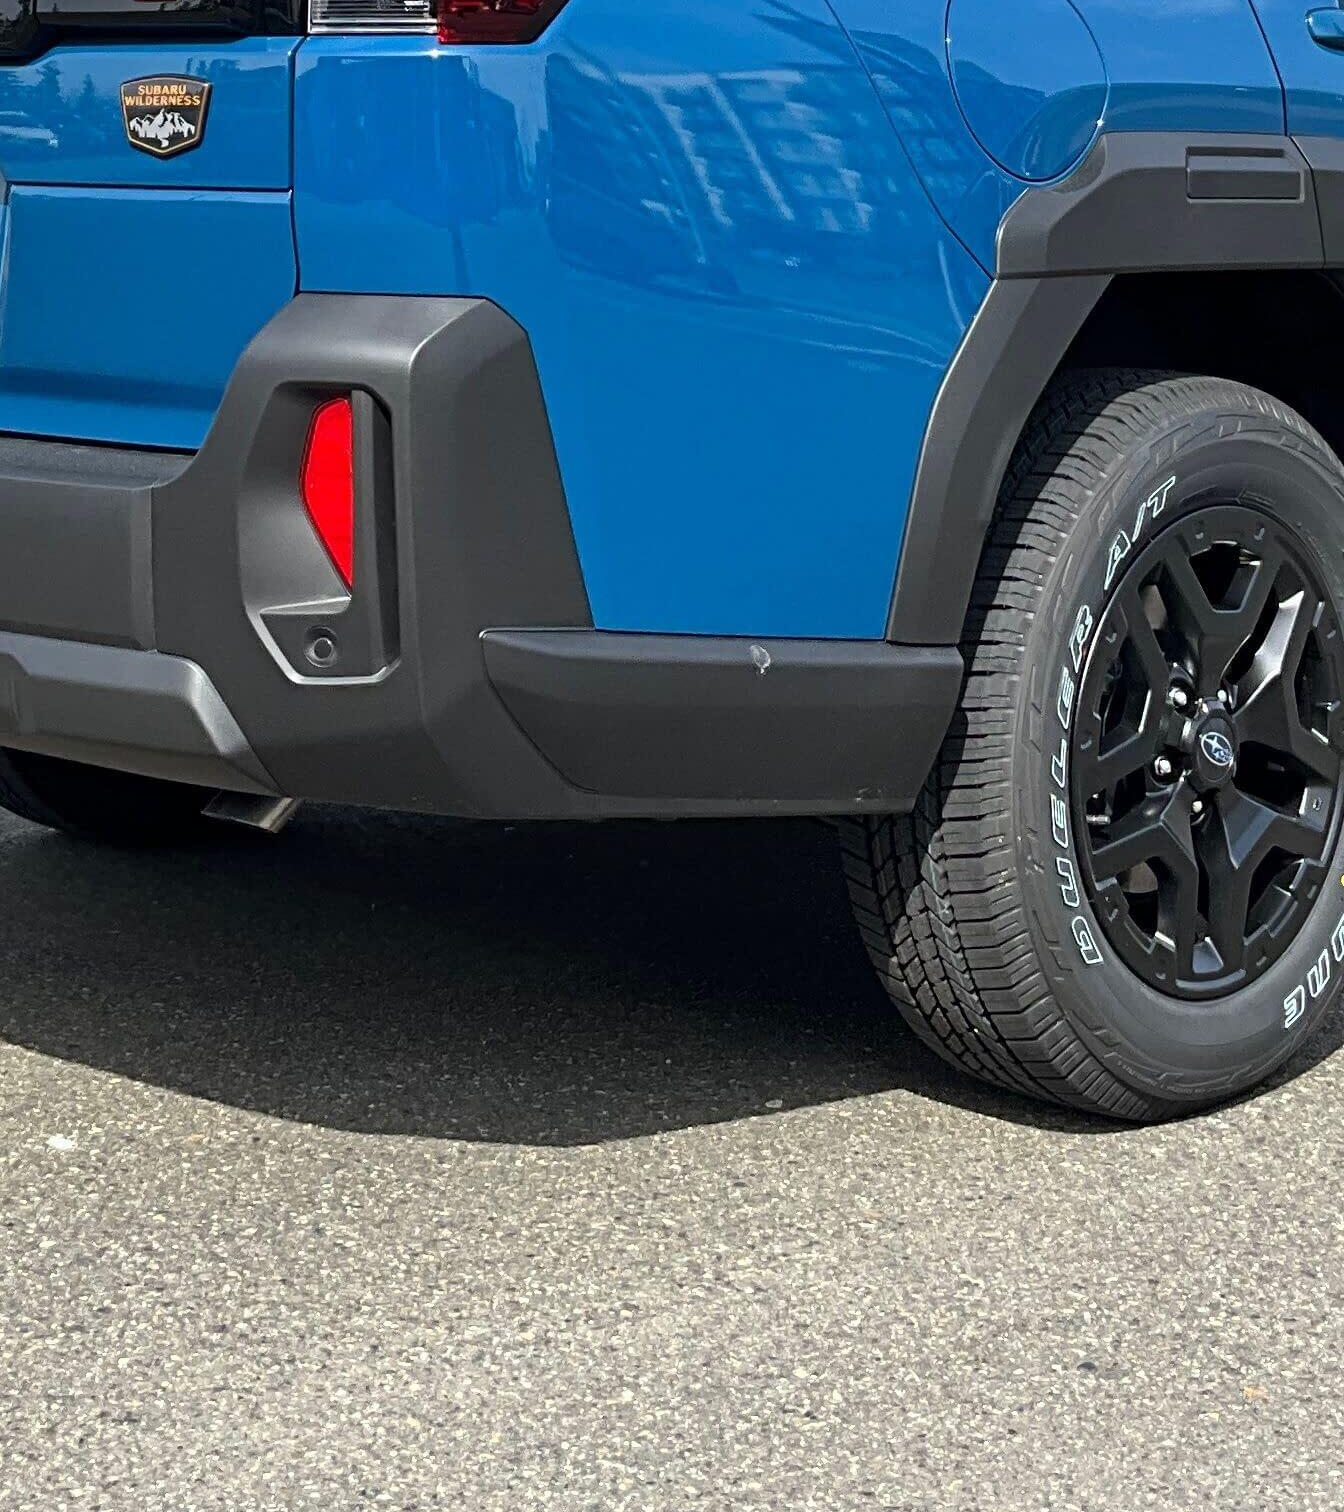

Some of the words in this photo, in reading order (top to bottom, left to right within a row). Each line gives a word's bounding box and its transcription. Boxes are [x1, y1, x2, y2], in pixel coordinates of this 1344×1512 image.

[138, 85, 187, 95] SUBARU
[125, 95, 201, 106] WILDERNESS
[1050, 605, 1103, 965] DUELER
[1104, 475, 1177, 590] A/T
